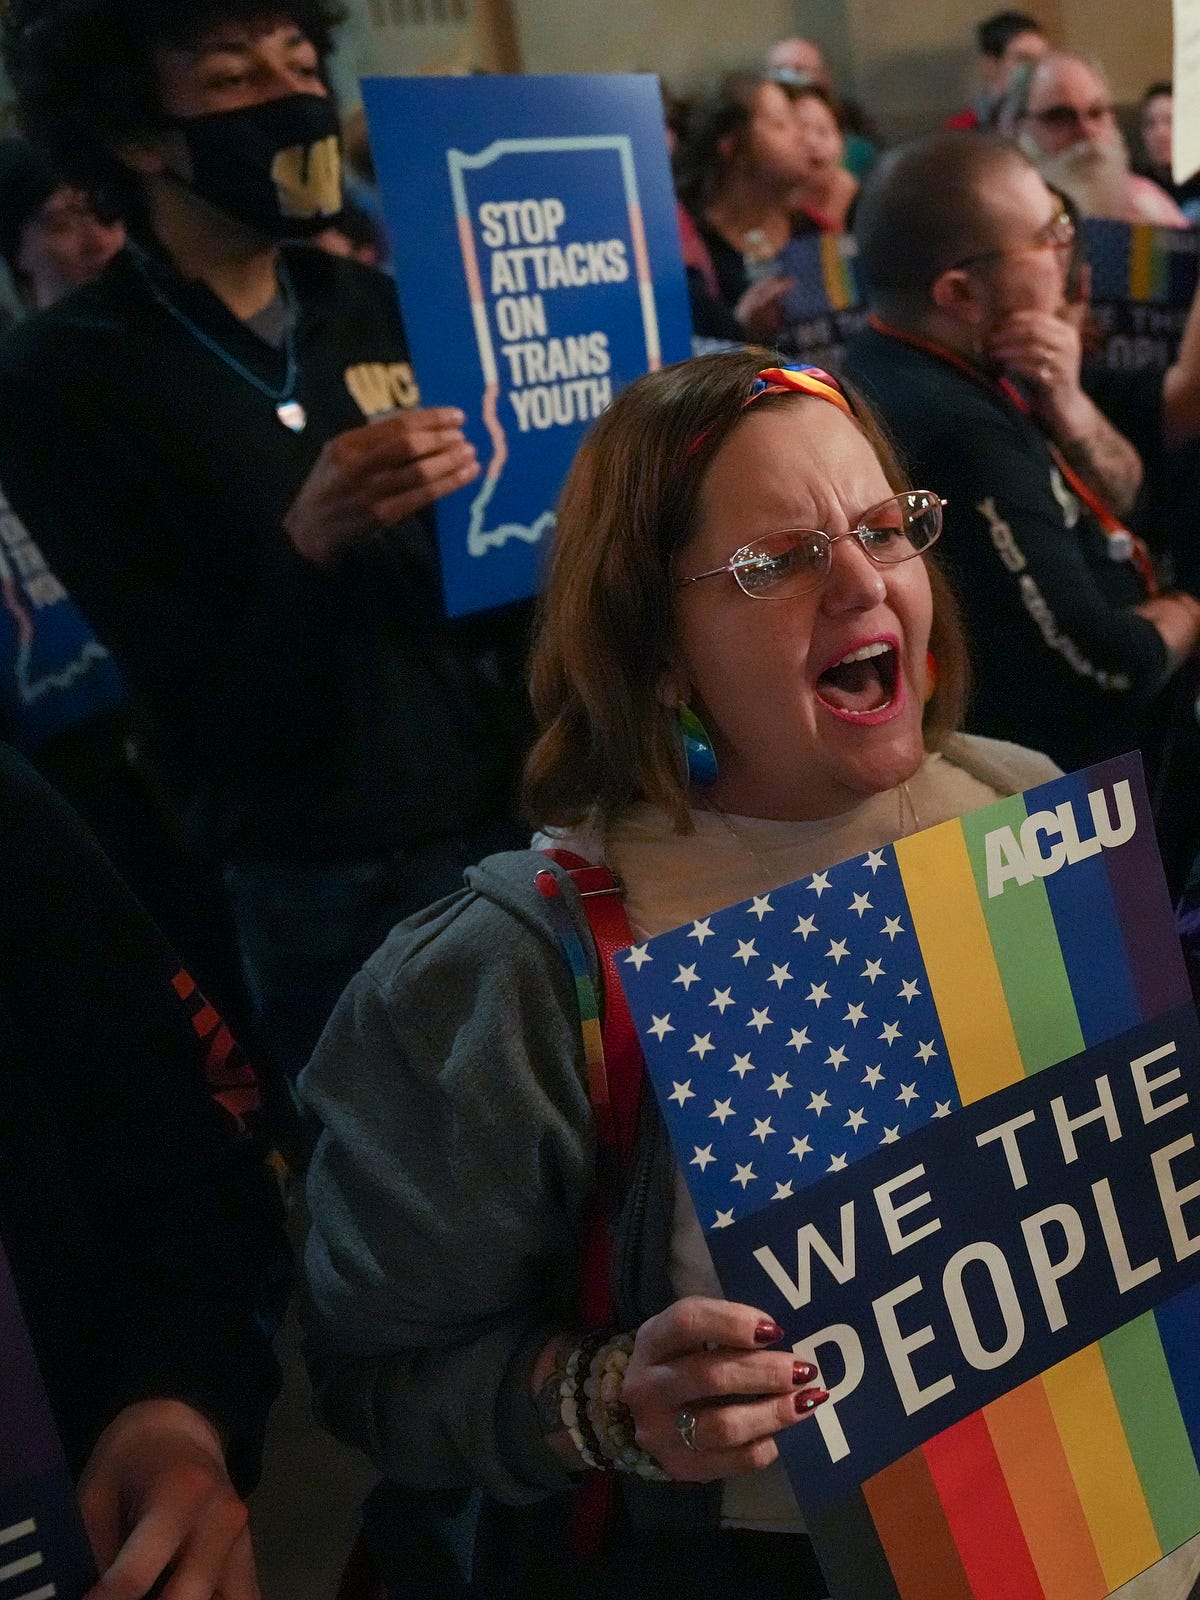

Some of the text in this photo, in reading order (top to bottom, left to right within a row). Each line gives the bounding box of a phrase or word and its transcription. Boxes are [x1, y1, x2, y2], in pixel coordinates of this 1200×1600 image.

[479, 198, 566, 249] STOP
[491, 239, 630, 295] ATTACKS
[496, 294, 549, 342] ON
[502, 331, 612, 387] TRANS
[509, 375, 613, 433] YOUTH
[984, 779, 1137, 899] ACLU
[752, 1040, 1190, 1311] WE THE
